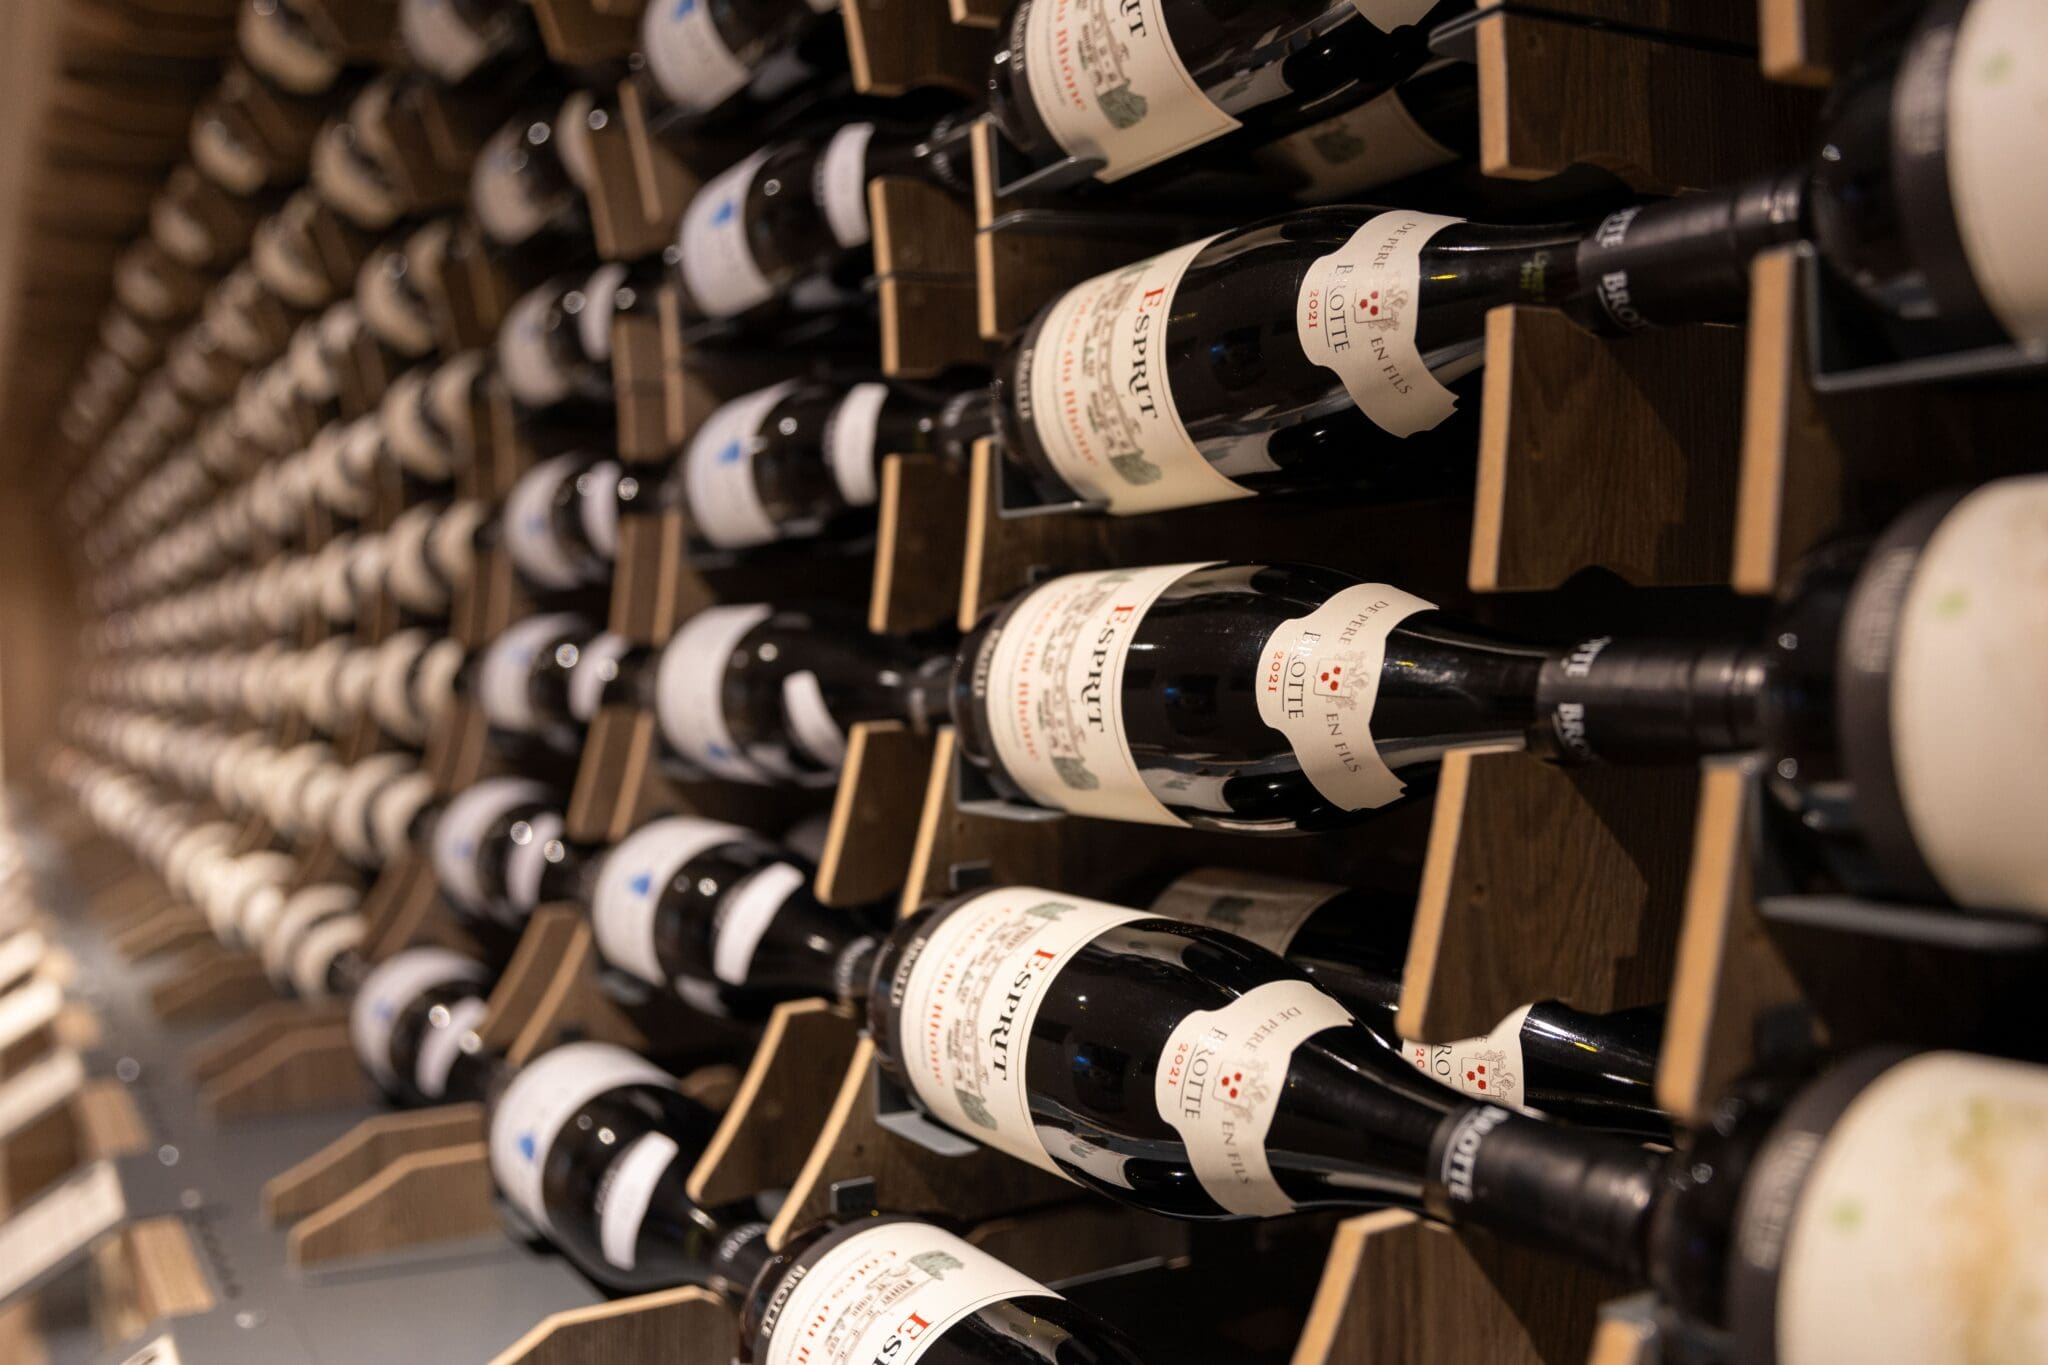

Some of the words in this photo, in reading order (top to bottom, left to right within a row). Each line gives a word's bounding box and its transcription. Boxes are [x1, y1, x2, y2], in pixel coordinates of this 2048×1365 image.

[1396, 222, 1417, 236] DE
[1308, 290, 1319, 329] 2021
[1130, 286, 1166, 420] ESPRIT
[1370, 337, 1388, 361] EN
[1381, 364, 1414, 396] FILS
[1367, 600, 1389, 616] DE
[1081, 605, 1137, 733] ESPRIT
[1267, 651, 1284, 693] 2021
[1326, 713, 1342, 736] EN
[1334, 742, 1362, 774] FILS
[989, 948, 1060, 1081] ESPRIT
[1280, 1006, 1302, 1022] DE
[1168, 1043, 1189, 1088] 2021
[1222, 1121, 1236, 1147] EN
[1228, 1152, 1249, 1185] FILS
[761, 1264, 808, 1339] BROTTE
